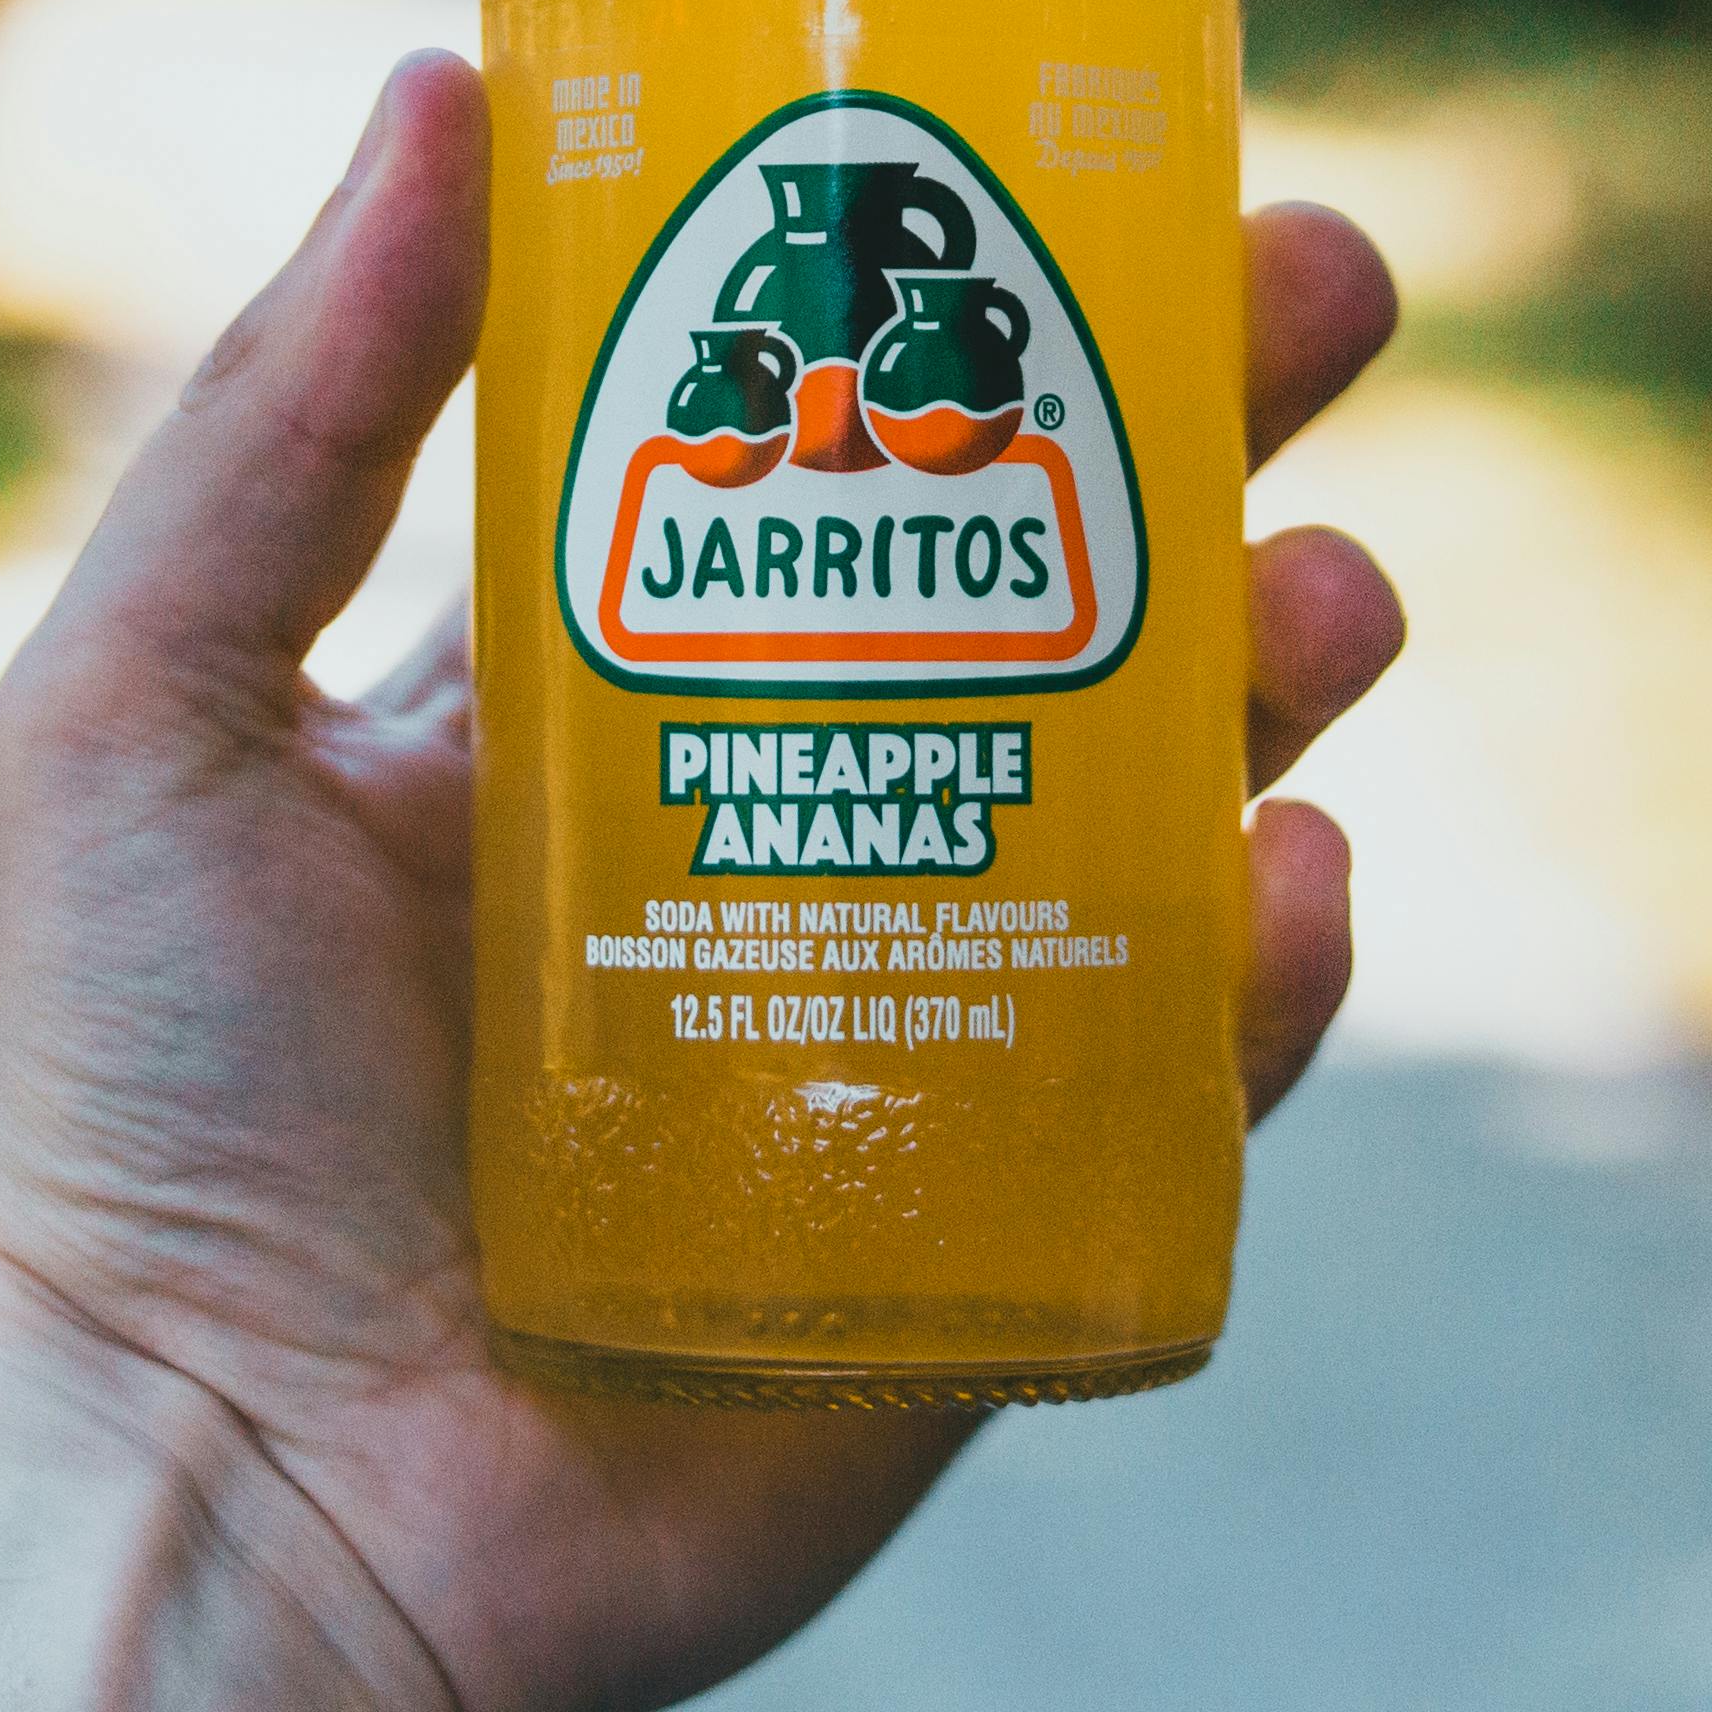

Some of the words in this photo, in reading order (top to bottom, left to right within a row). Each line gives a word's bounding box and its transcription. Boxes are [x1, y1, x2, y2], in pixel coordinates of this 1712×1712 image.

[552, 75, 610, 112] MADE
[618, 72, 641, 107] IN
[556, 112, 635, 152] MEXICO
[640, 514, 1051, 601] JARRITOS
[668, 732, 1023, 795] PINEAPPLE
[701, 801, 988, 866] ANANAS
[645, 899, 714, 934] SODA
[720, 901, 791, 934] WITH
[799, 902, 928, 935] NATURAL
[936, 899, 1070, 934] FLAVOURS
[585, 934, 687, 970] BOISSON
[693, 938, 815, 971] GAZEUSE
[821, 939, 881, 972] AUX
[887, 931, 1004, 972] ARÔMES
[1011, 934, 1130, 970] NATURELS
[670, 993, 723, 1040] 12.5
[730, 995, 760, 1040] FL
[767, 994, 846, 1046] OZ/OZ
[852, 994, 897, 1044] LIQ
[904, 994, 961, 1052] (370
[967, 993, 1016, 1050] mL)
